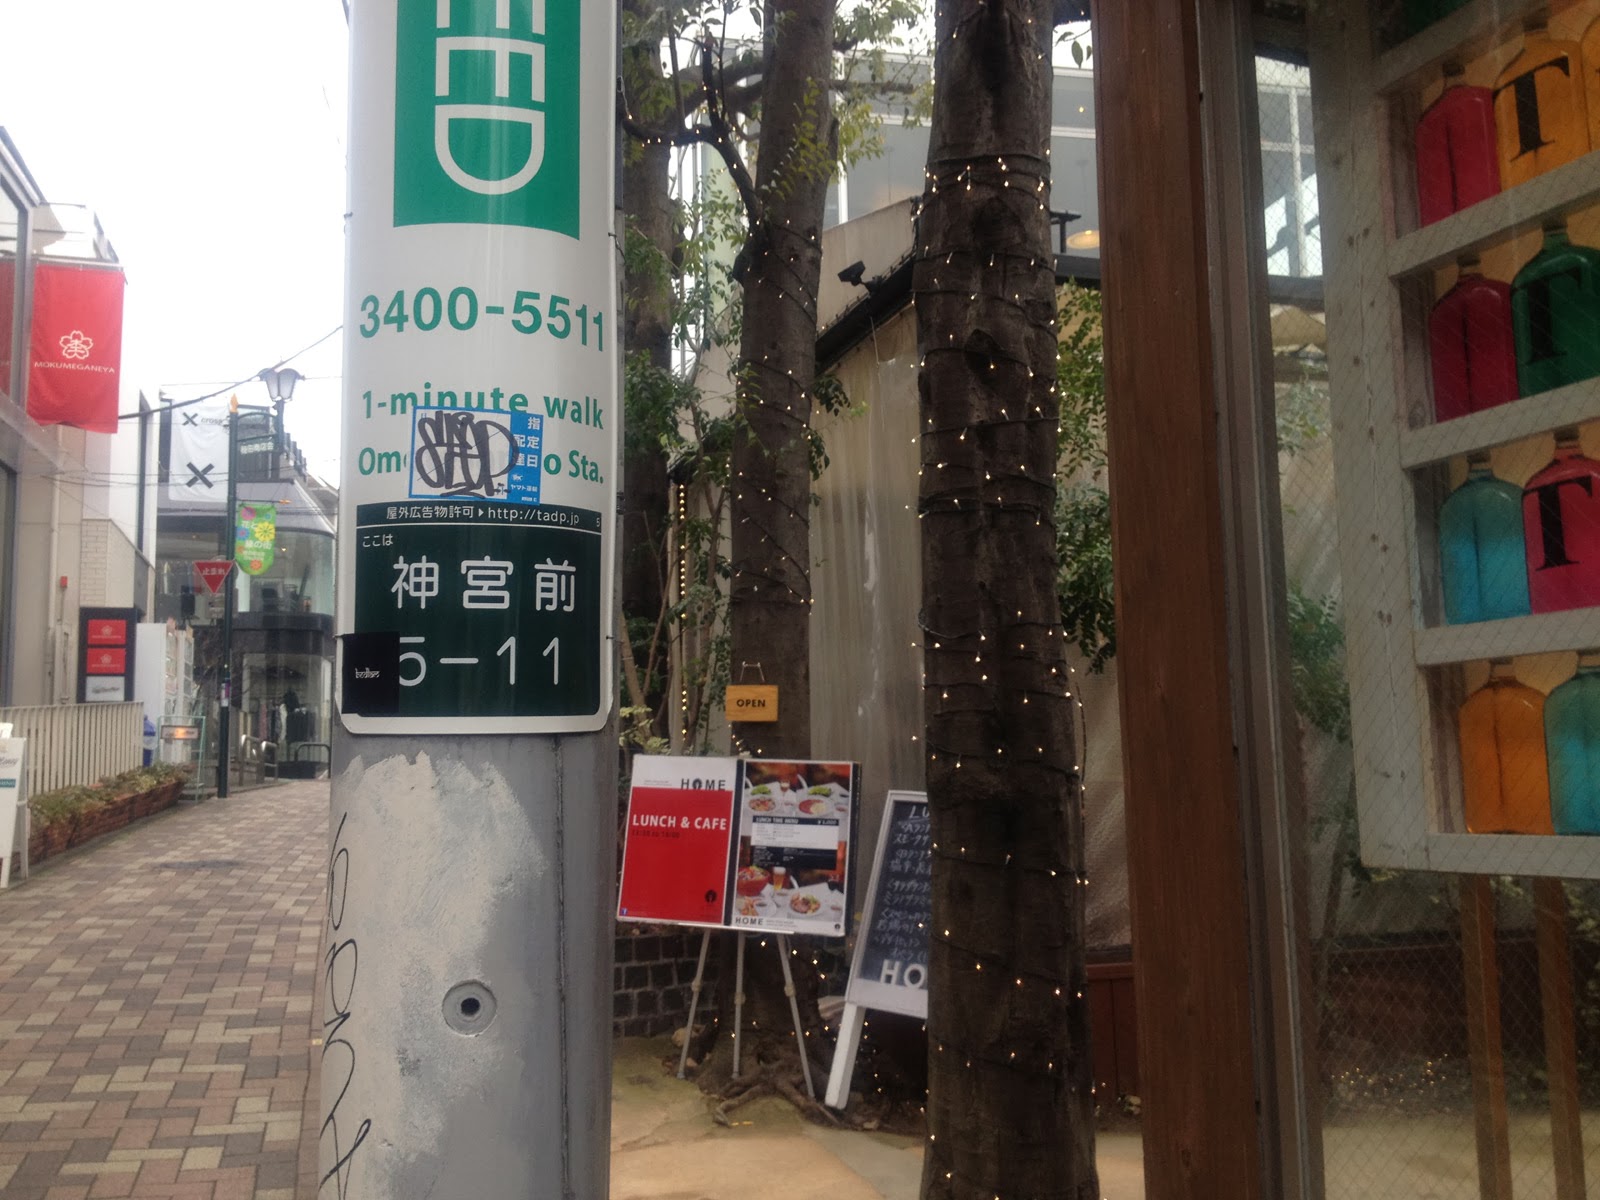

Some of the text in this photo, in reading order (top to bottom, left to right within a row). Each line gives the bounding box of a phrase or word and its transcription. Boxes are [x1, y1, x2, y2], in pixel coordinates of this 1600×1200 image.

[359, 286, 604, 352] 3400-5511
[34, 361, 116, 374] MOKUMEGANEYA
[362, 382, 605, 430] 1-minute walk
[567, 449, 604, 485] Sta.
[386, 505, 474, 520] 屋外広告物許可
[487, 506, 580, 526] http://tadp.jp
[362, 533, 394, 548] ここは
[390, 554, 577, 613] 神宮前
[735, 698, 766, 708] OPEN
[680, 777, 727, 792] HOME
[632, 814, 728, 831] LUNCH & CAFE
[735, 916, 764, 926] HOME
